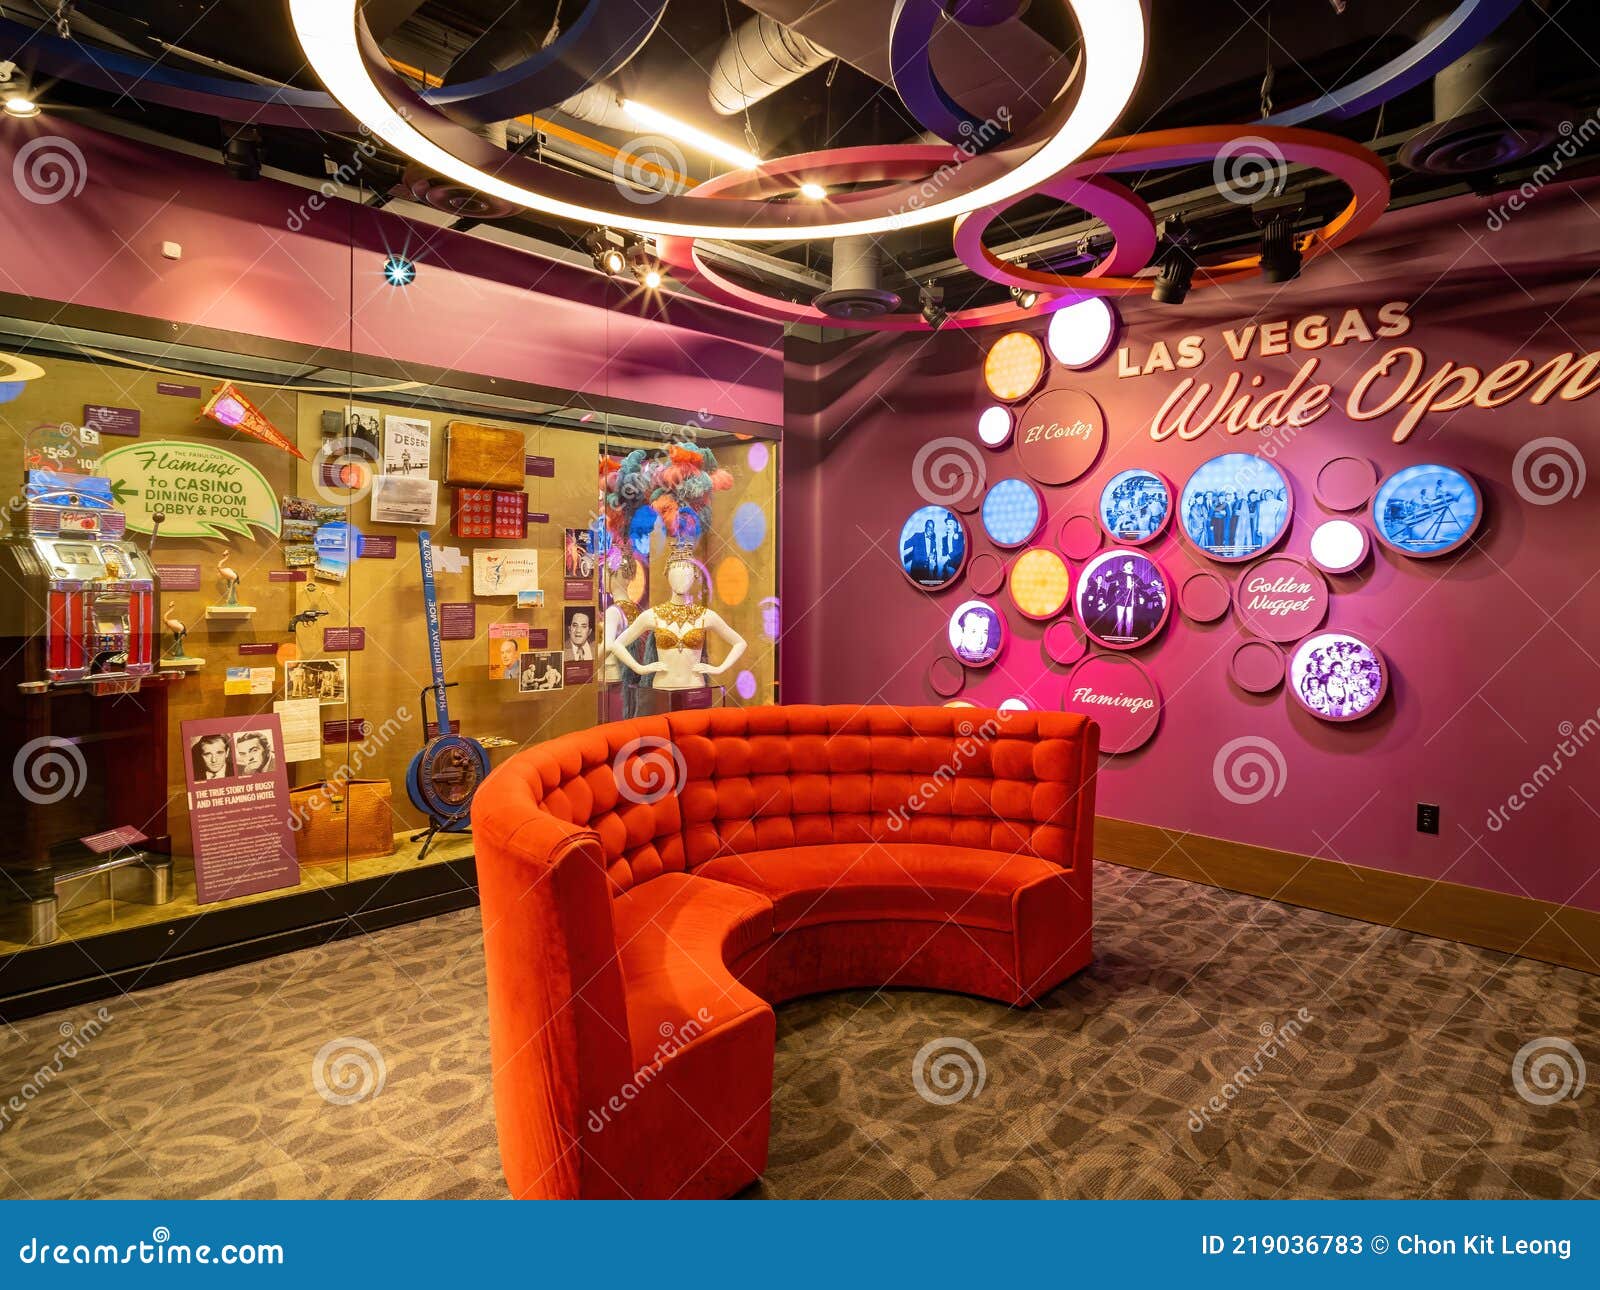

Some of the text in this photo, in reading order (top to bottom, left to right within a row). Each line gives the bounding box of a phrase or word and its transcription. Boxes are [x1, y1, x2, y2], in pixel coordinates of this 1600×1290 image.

[1117, 301, 1412, 380] LAS VEGAS
[1148, 345, 1600, 444] Wide Open
[1024, 419, 1093, 444] El Cortez
[134, 450, 240, 478] Flamingo
[148, 475, 243, 494] to CASINO
[145, 489, 247, 506] DINING ROOM
[145, 502, 248, 519] LOBBY & POOL
[1247, 576, 1312, 594] Golden
[1247, 594, 1316, 616] Nugget
[432, 629, 443, 673] BIRTHDAY
[1072, 687, 1154, 713] Flamingo
[196, 781, 275, 799] THE TRUE STORY OF BUGSY
[196, 791, 275, 809] AND THE FLAMINGO HOTEL
